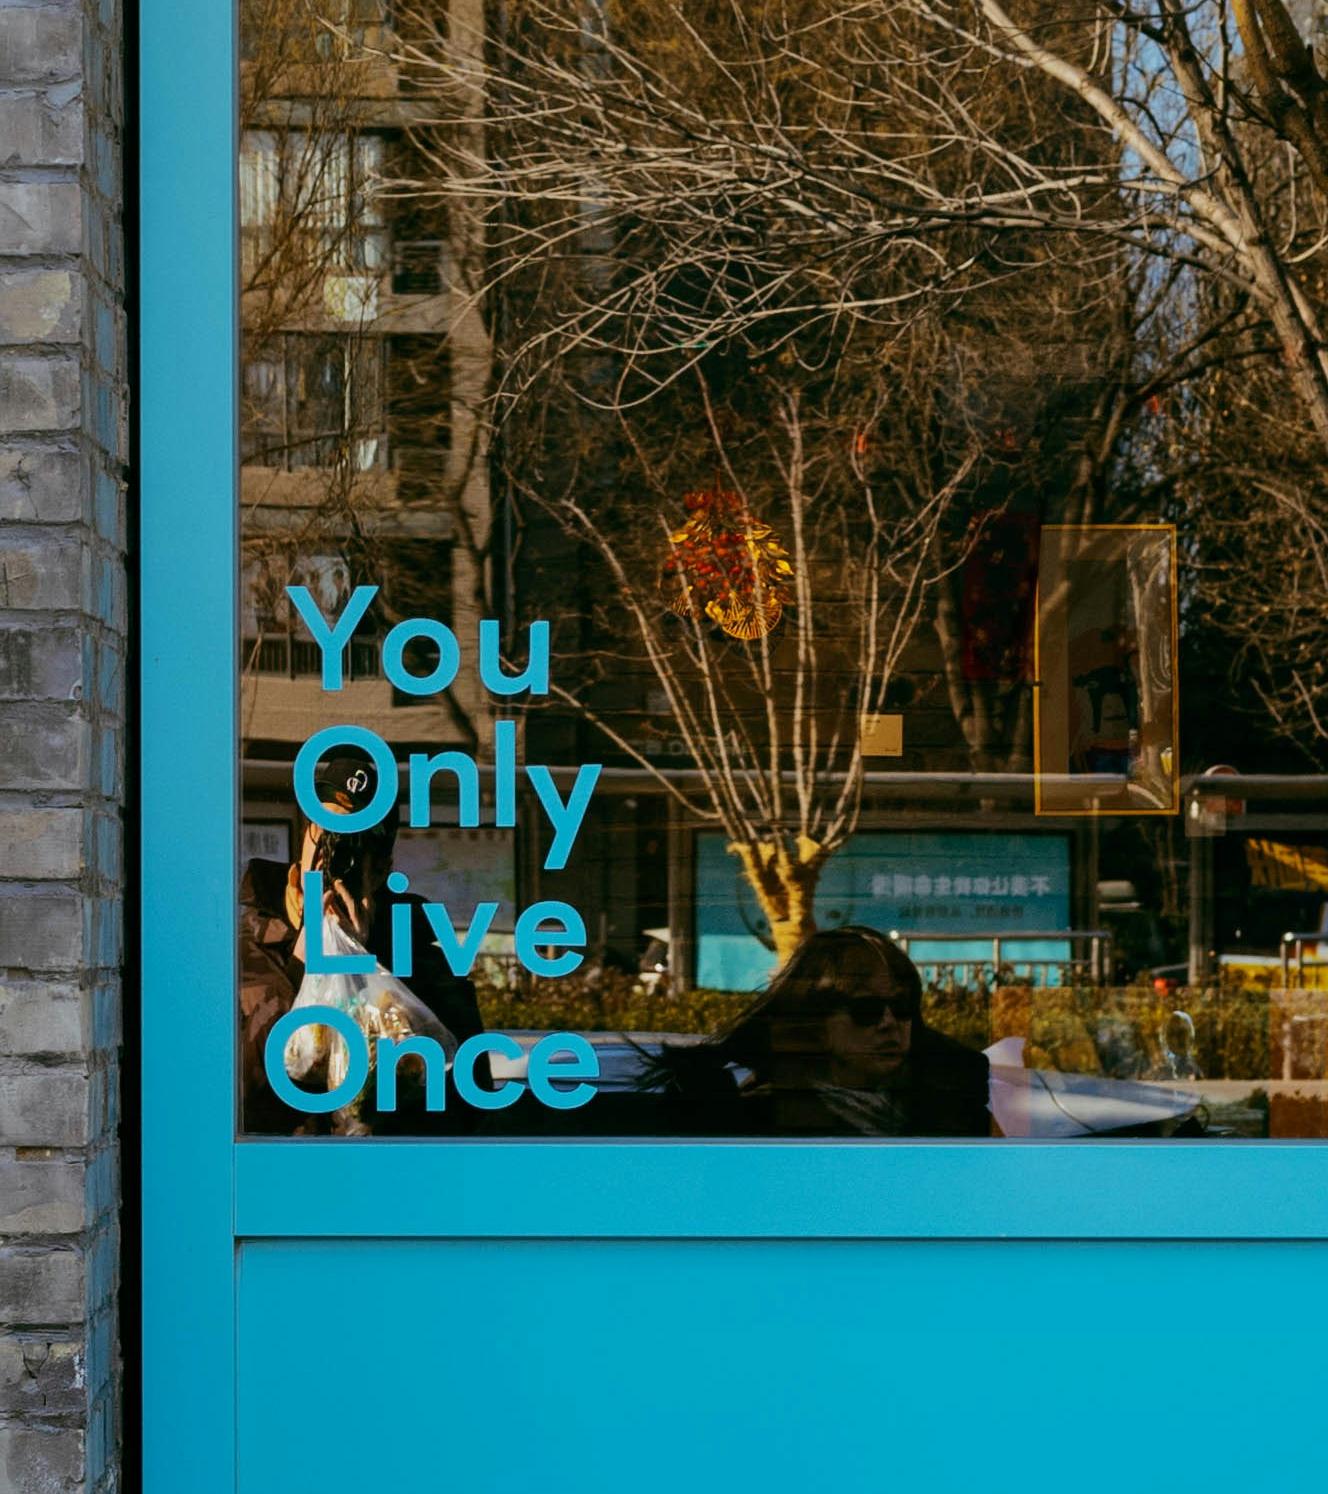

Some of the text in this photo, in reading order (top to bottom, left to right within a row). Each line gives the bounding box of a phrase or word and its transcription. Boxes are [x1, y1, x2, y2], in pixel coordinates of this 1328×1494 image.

[284, 585, 551, 696] You
[293, 719, 603, 870] Only
[303, 870, 588, 978] Live
[264, 1004, 602, 1114] Once
